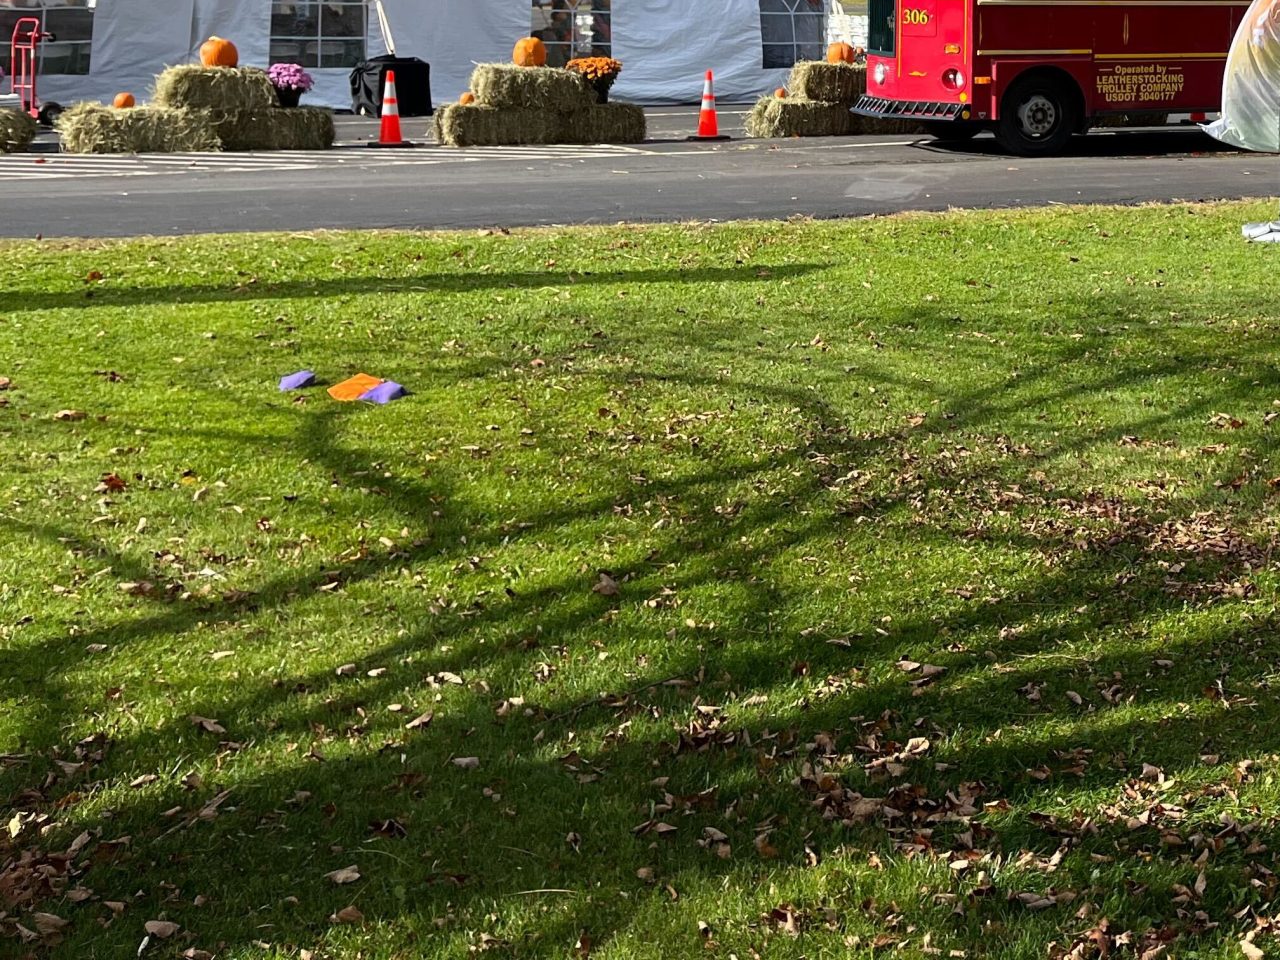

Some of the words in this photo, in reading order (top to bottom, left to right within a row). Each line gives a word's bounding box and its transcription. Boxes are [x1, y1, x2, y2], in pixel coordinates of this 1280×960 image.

[903, 9, 928, 25] 306
[1114, 65, 1154, 75] Operated
[1156, 64, 1167, 75] by
[1096, 74, 1184, 85] LEATHERSTOCKING
[1096, 84, 1138, 93] TROLLEY
[1140, 83, 1184, 92] COMPANY
[1105, 93, 1136, 102] USDOT
[1139, 91, 1175, 100] 3040177
